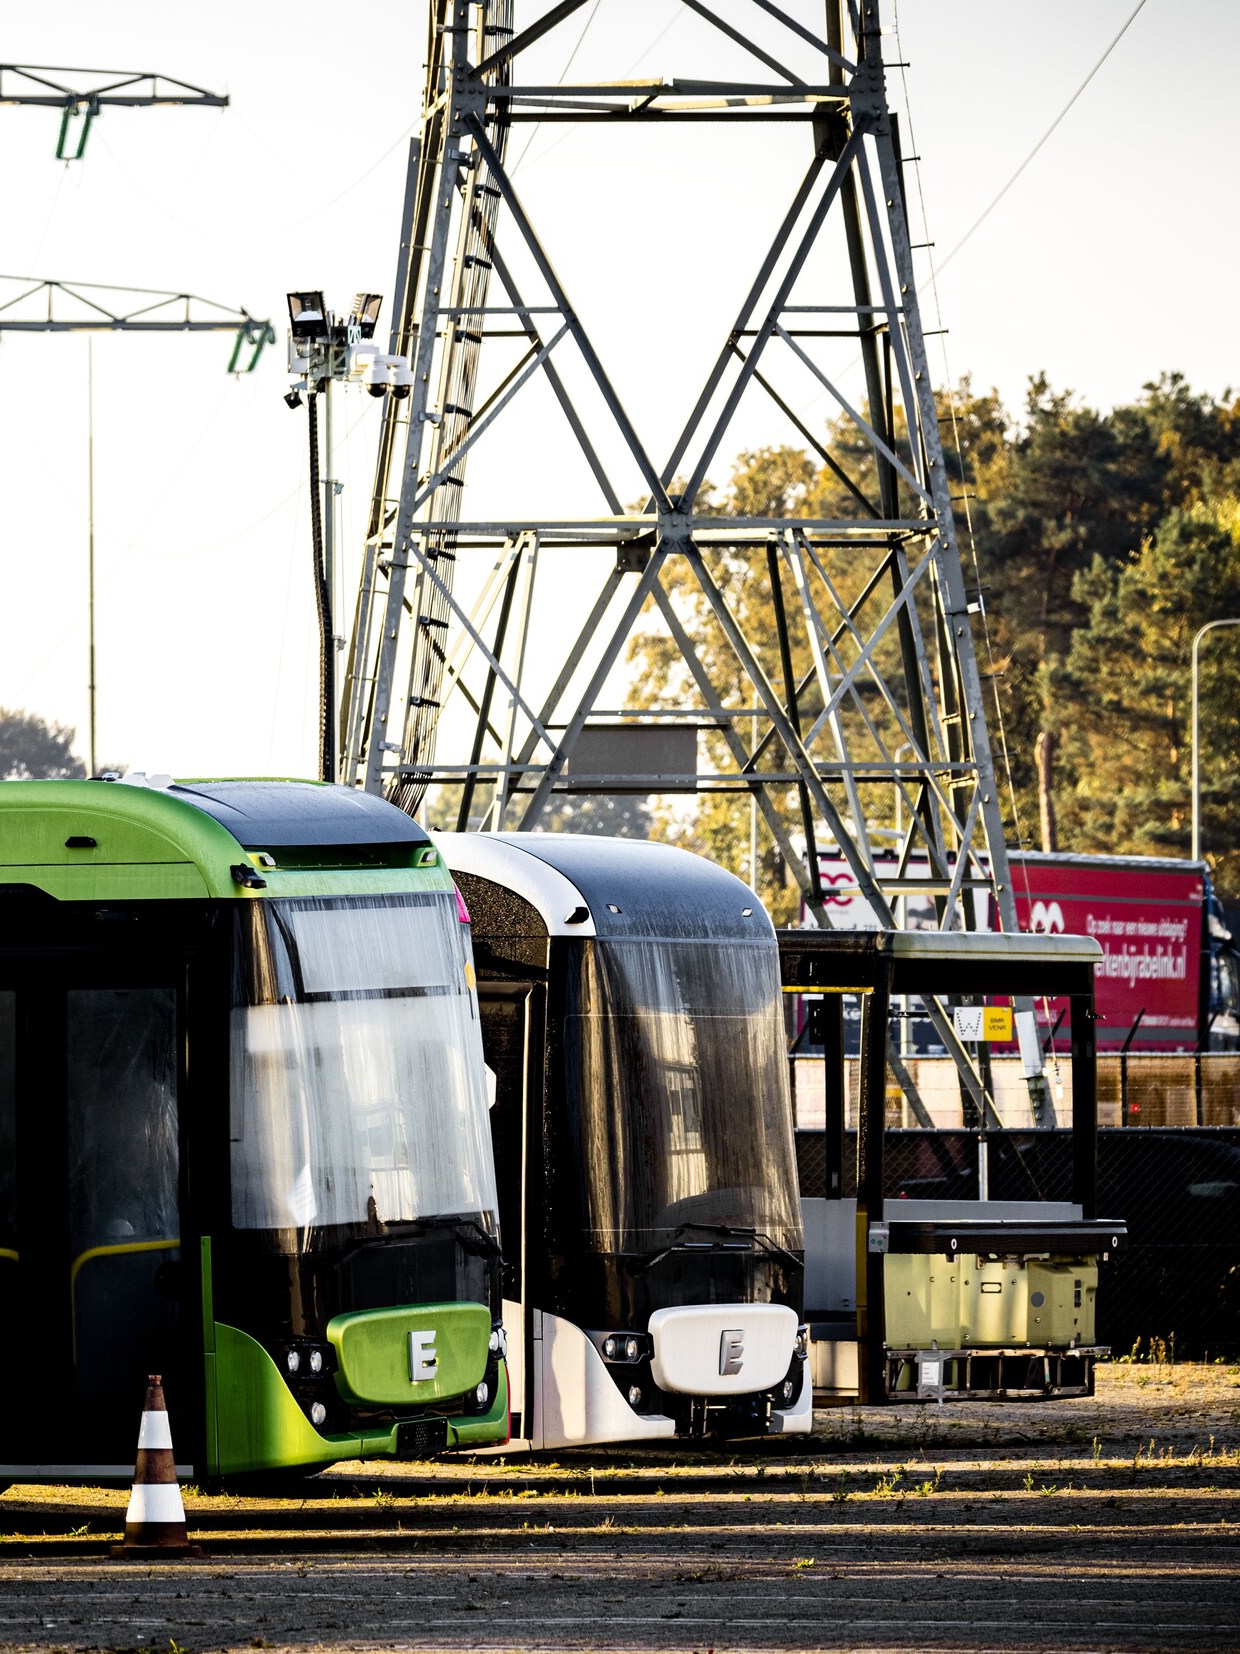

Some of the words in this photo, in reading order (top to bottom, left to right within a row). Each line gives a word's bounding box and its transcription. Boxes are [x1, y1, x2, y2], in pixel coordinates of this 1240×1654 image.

[1087, 914, 1097, 937] Op
[1097, 914, 1111, 935] zoek
[1112, 920, 1124, 936] naar
[1125, 921, 1137, 936] een
[1138, 917, 1157, 937] nieuwe
[1158, 917, 1188, 942] uitdaging?
[1094, 942, 1187, 988] erkenbijrabelink.nl
[408, 1330, 438, 1381] E
[719, 1329, 745, 1376] E
